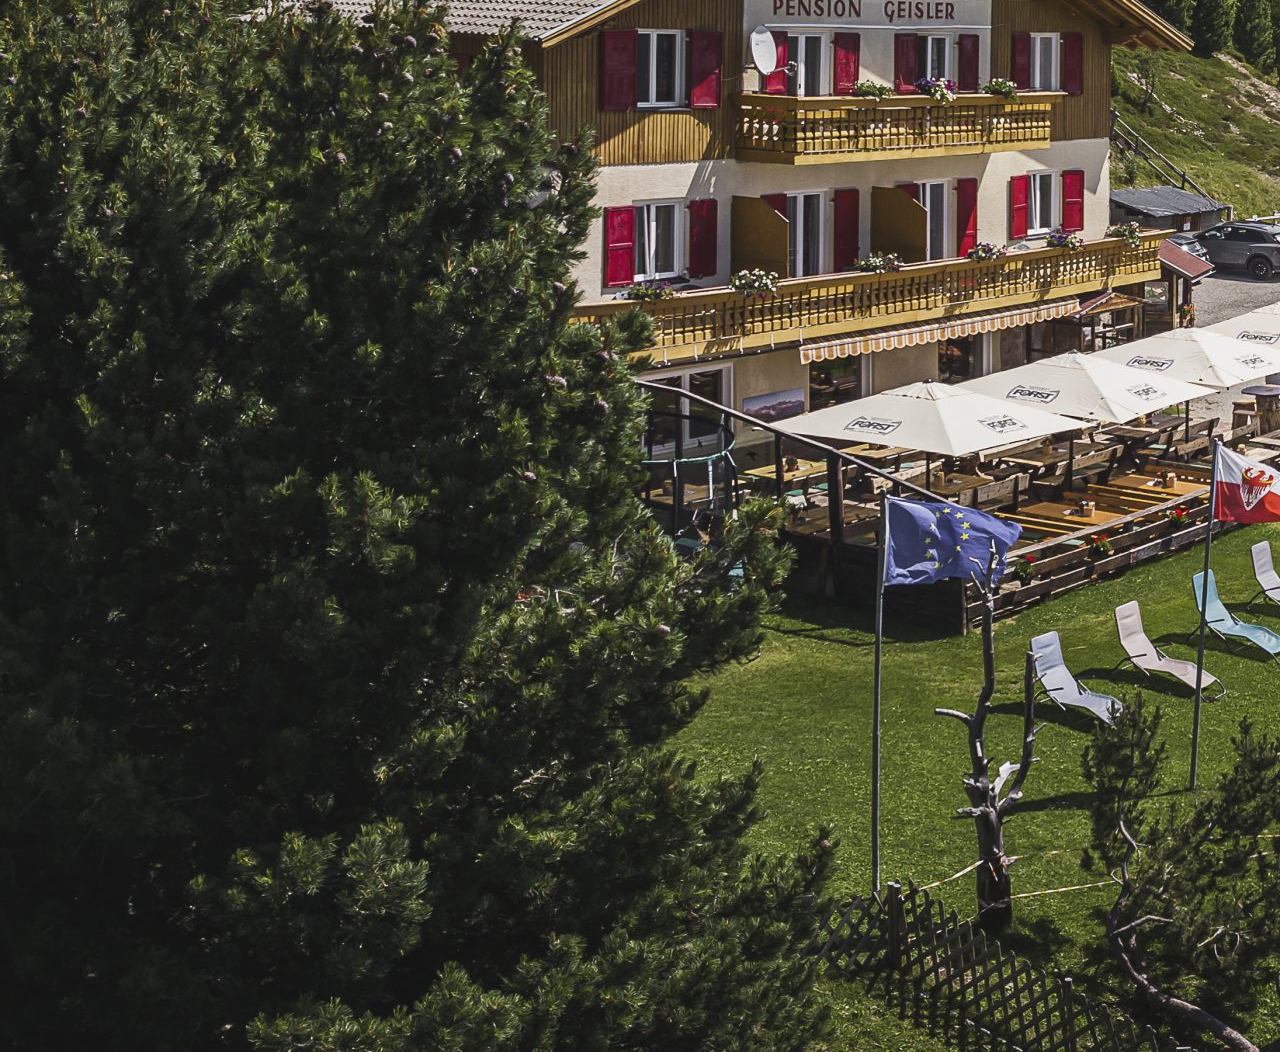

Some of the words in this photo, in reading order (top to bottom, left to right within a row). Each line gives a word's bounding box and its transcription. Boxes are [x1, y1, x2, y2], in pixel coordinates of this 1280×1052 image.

[883, 0, 955, 23] GEISLER
[1241, 331, 1275, 342] FORST
[1132, 358, 1168, 368] FORST
[1012, 388, 1055, 400] FORST
[852, 420, 896, 431] FORST
